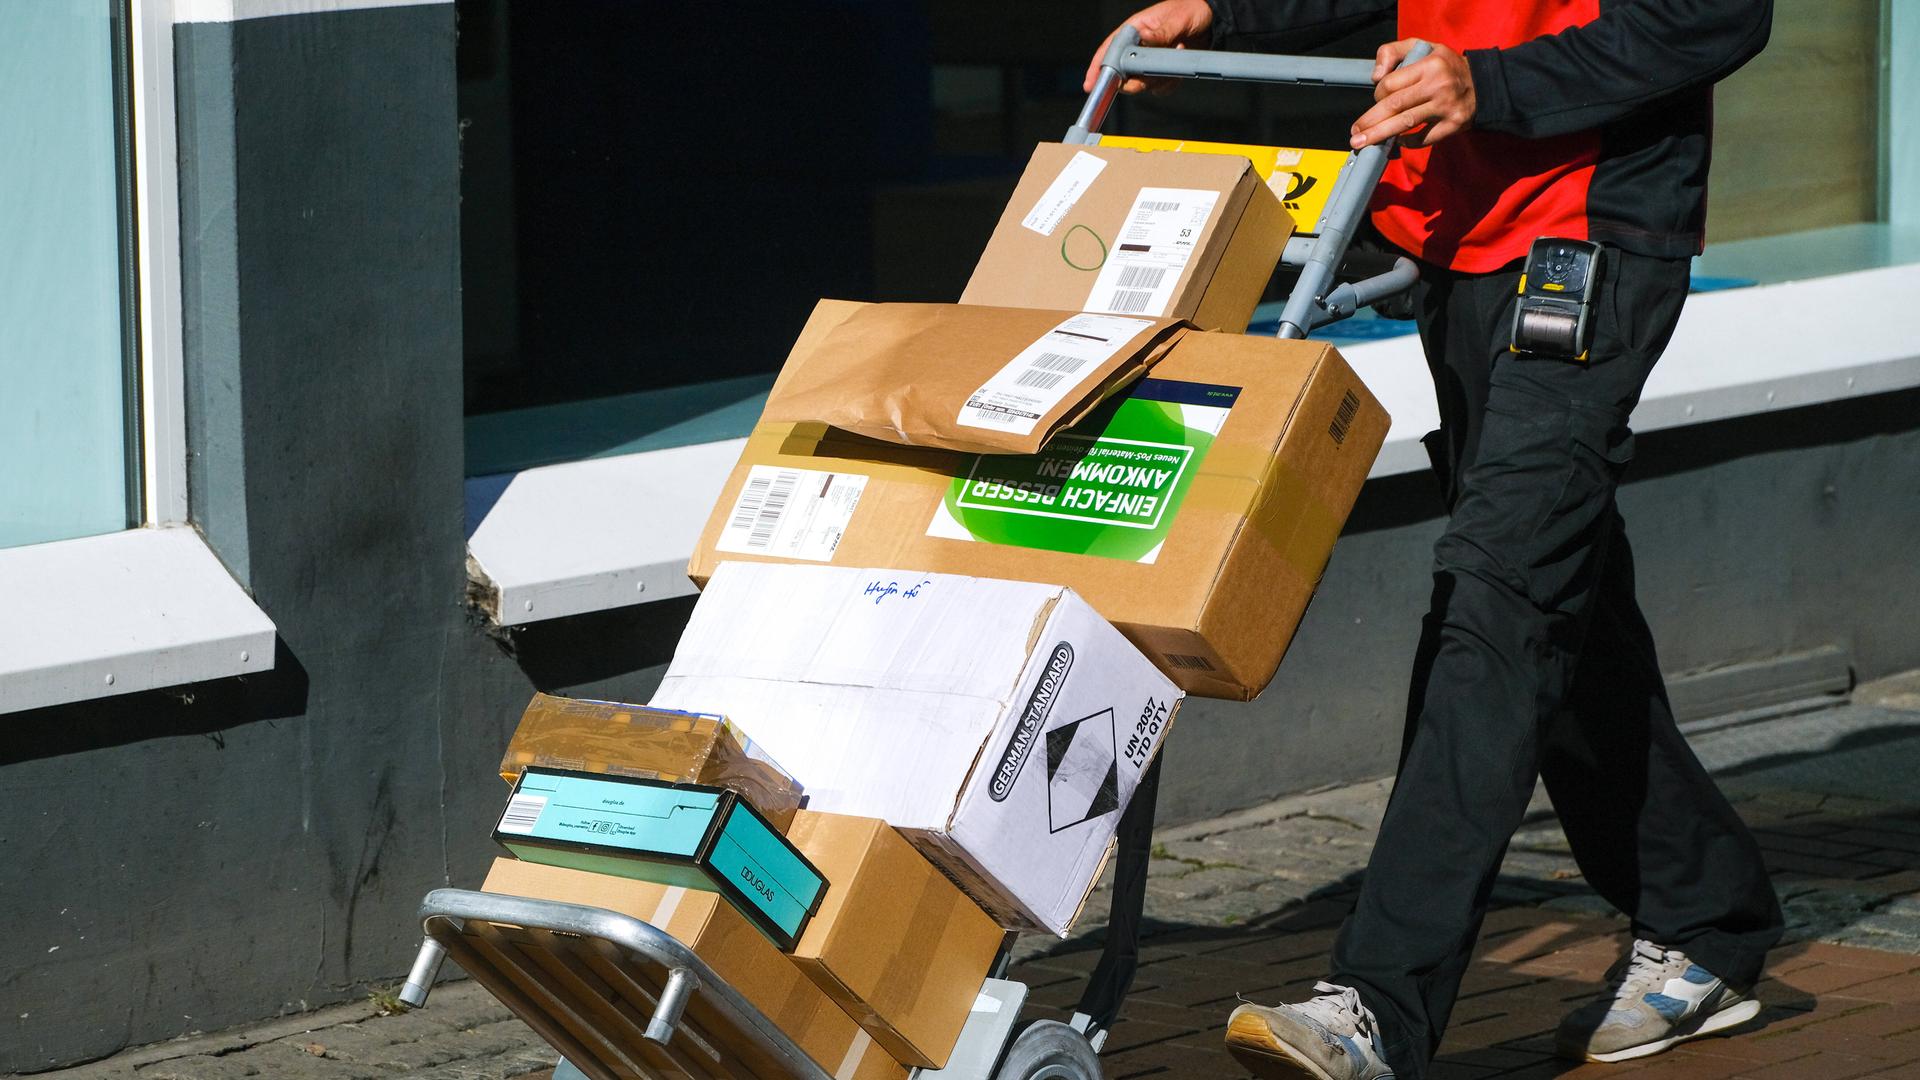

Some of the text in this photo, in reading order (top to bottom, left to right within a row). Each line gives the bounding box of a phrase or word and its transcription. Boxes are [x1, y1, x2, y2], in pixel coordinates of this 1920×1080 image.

[1179, 228, 1192, 238] 53
[1099, 448, 1151, 462] PoS-Material
[1151, 453, 1181, 465] Neues
[1037, 459, 1172, 489] ANKOMMEN!
[972, 476, 1159, 517] EINFACH BESSER
[993, 648, 1069, 796] GERMAN STANDARD
[1124, 697, 1157, 759] UN 2037
[1132, 701, 1168, 769] LTD QTY
[741, 866, 774, 901] DOUGLAS
